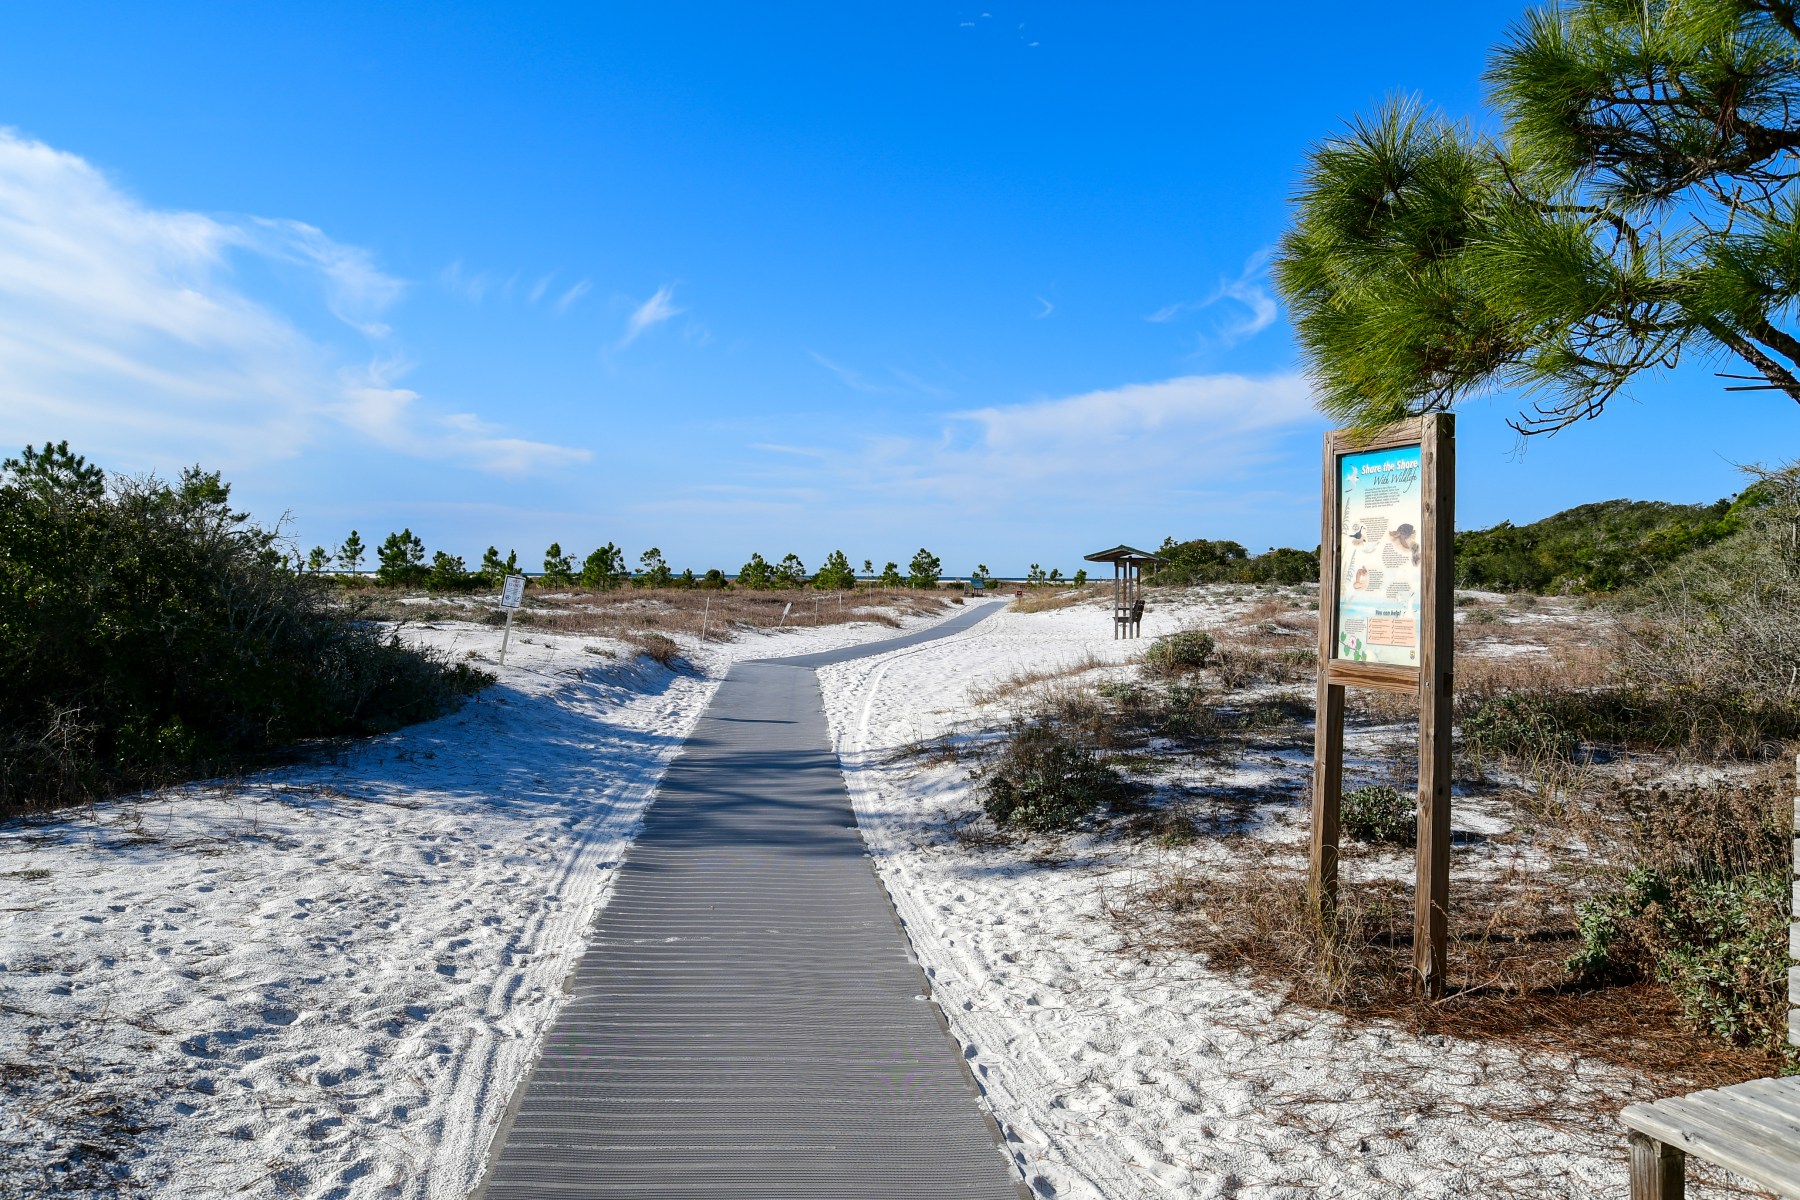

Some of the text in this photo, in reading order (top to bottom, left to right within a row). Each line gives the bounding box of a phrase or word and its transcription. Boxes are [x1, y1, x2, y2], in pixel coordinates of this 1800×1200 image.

[1362, 459, 1418, 475] Share the Shore
[1374, 471, 1390, 485] With
